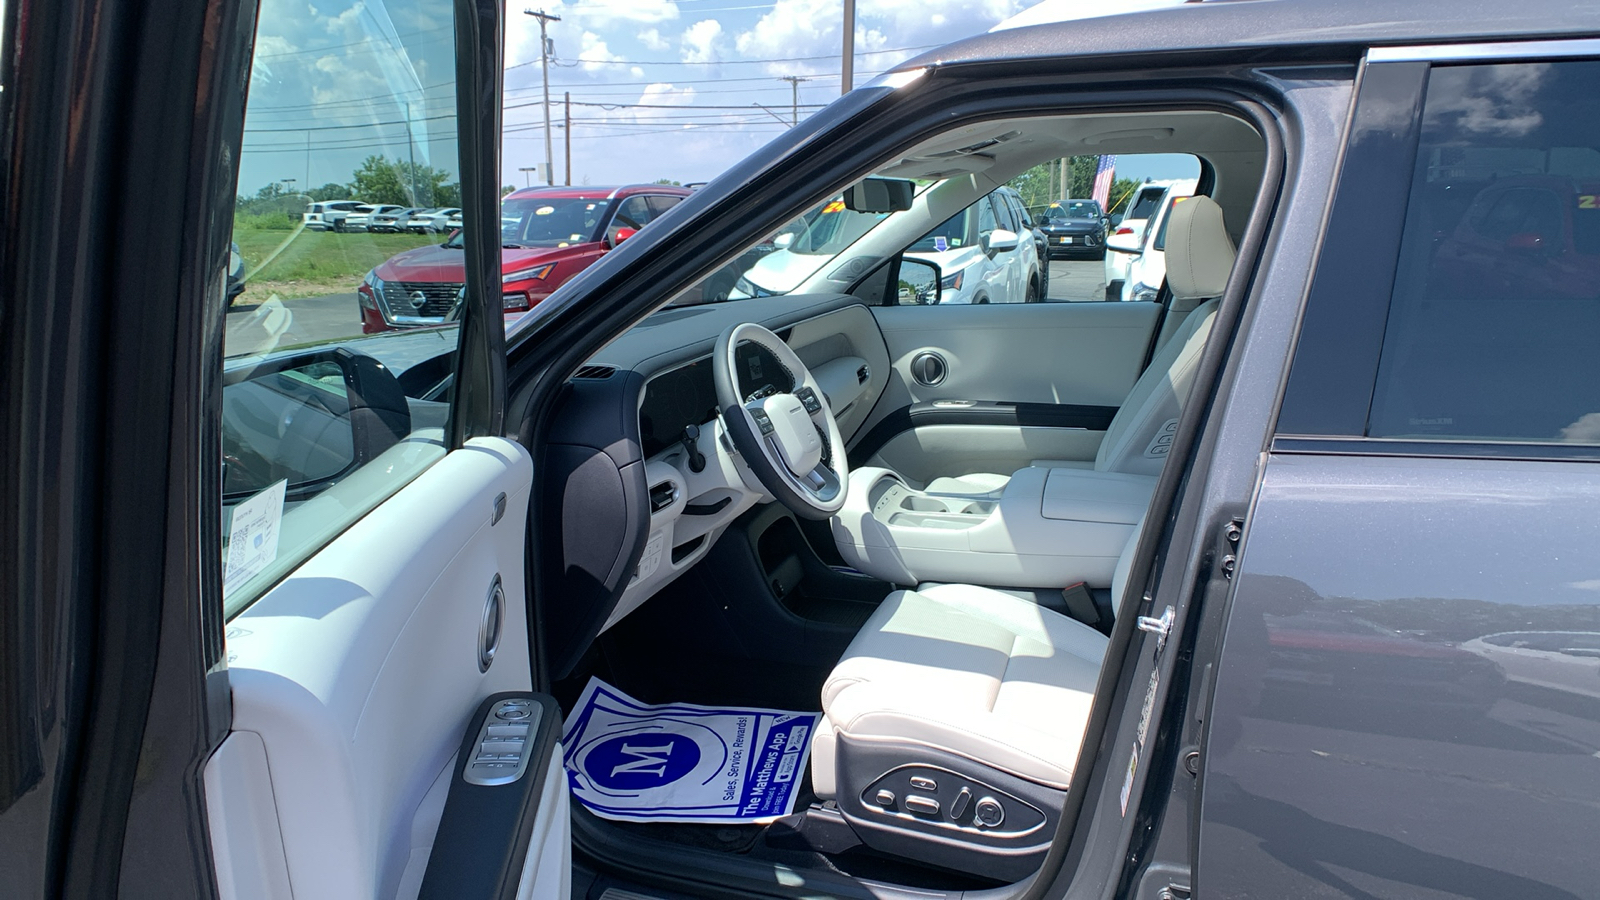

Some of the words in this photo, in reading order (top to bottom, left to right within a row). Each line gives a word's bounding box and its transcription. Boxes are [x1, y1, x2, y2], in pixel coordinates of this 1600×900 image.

[775, 715, 791, 723] NEW
[733, 717, 747, 747] Rewards!
[769, 733, 787, 750] App
[610, 741, 674, 778] M
[728, 749, 744, 777] Service,
[750, 751, 779, 795] Matthews
[723, 779, 739, 800] Sales,
[741, 797, 761, 816] The
[761, 791, 775, 811] Download
[771, 805, 780, 814] Join
[775, 795, 785, 805] FREE
